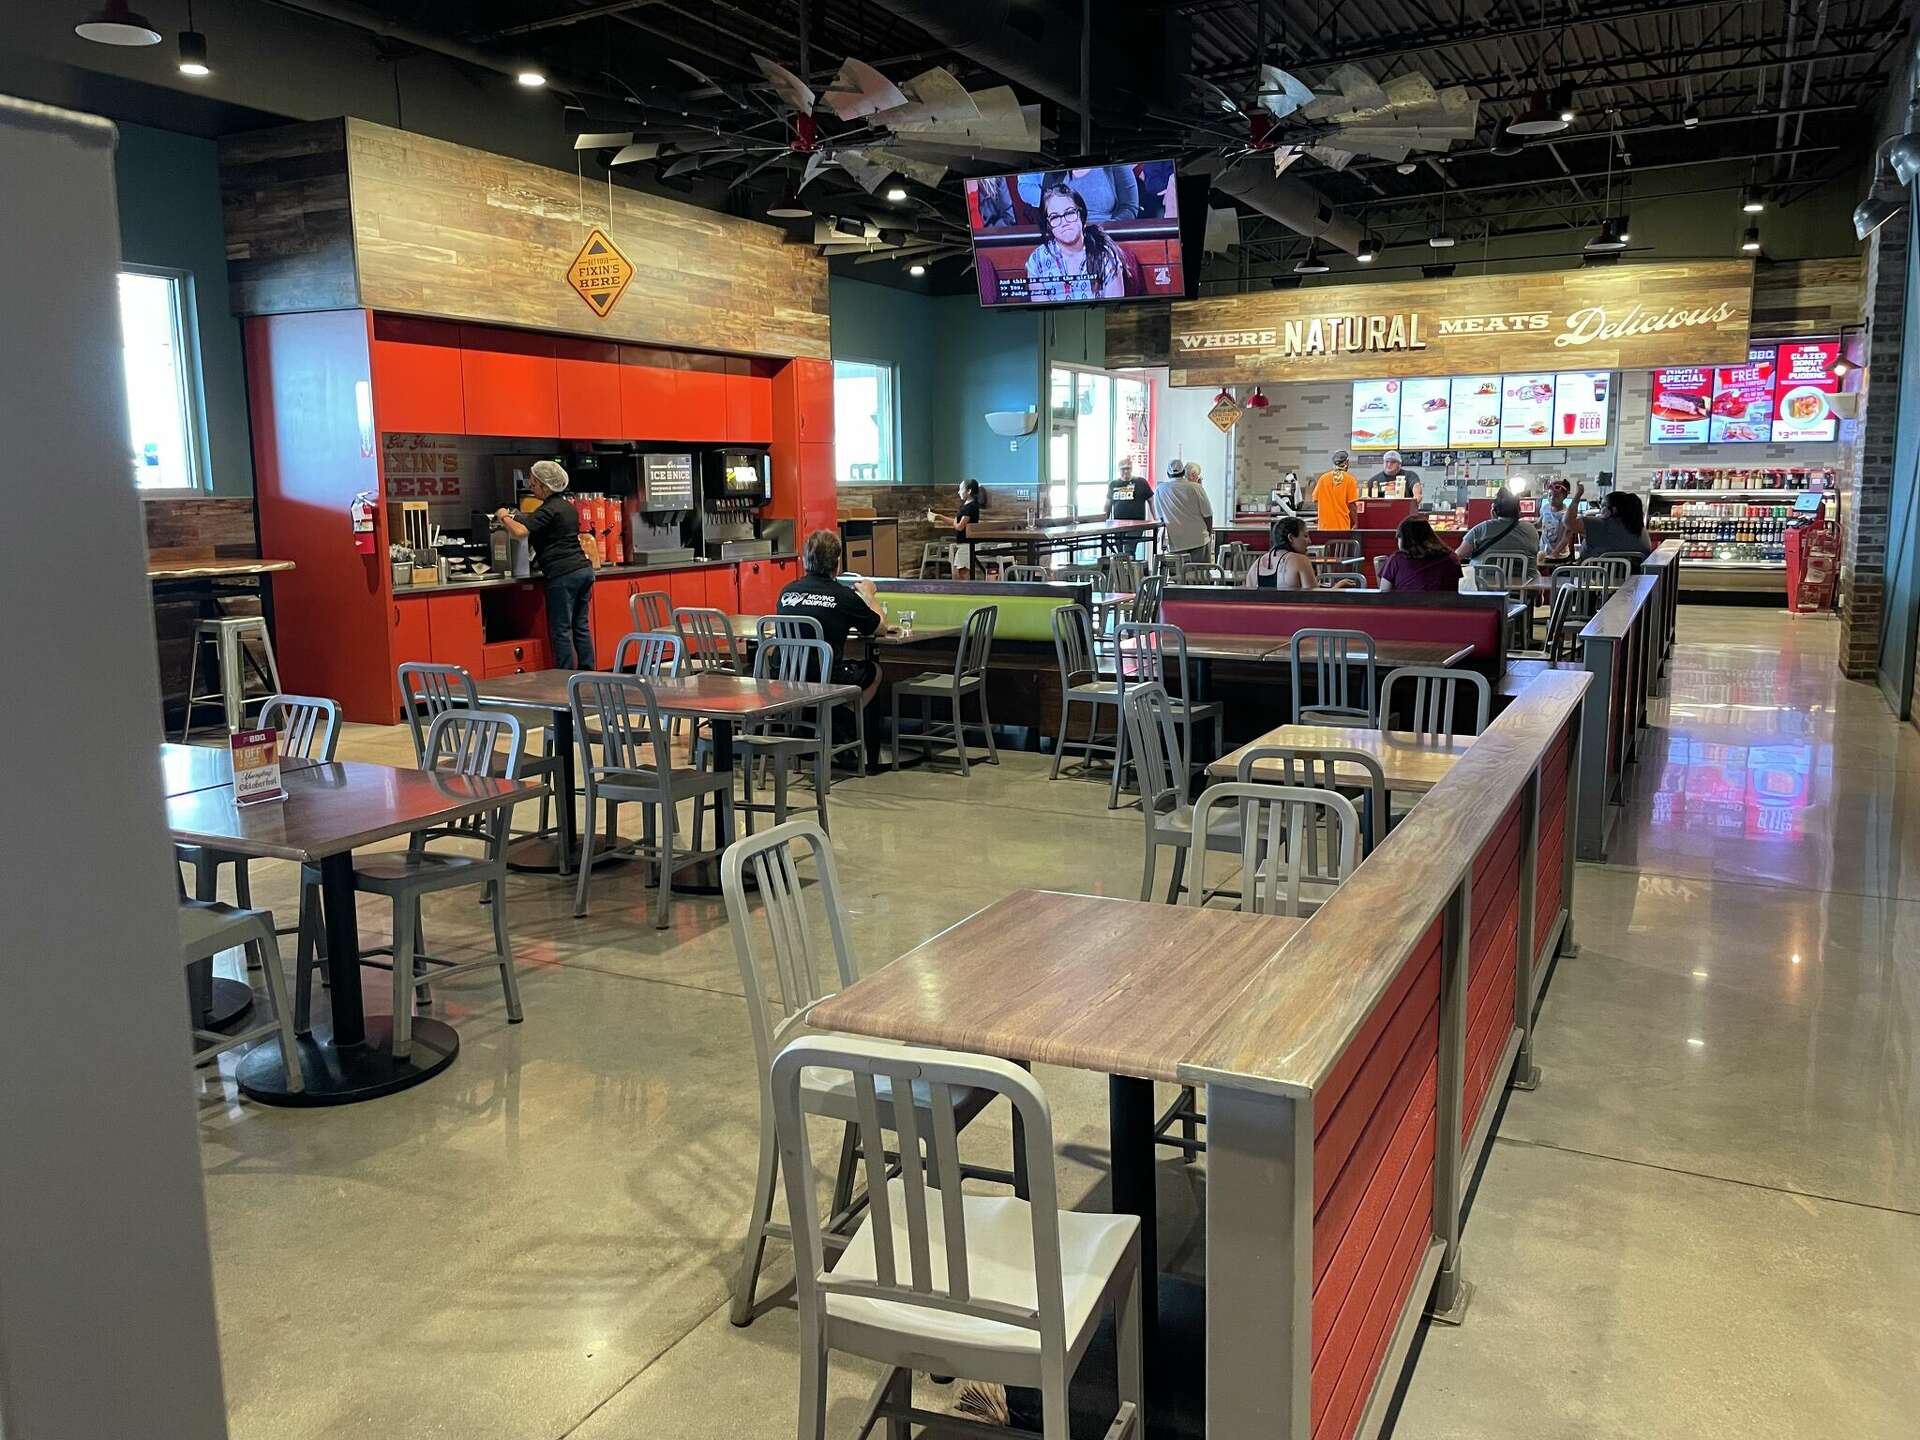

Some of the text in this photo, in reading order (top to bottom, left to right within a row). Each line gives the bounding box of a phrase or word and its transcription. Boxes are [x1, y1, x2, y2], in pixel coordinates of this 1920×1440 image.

[579, 264, 620, 277] FIXIN'S
[579, 276, 620, 288] HERE
[1180, 302, 1736, 355] WHERE NATURAL MEATS Delicious
[1659, 374, 1707, 383] SPECIAL
[1731, 368, 1760, 382] FREE
[1579, 417, 1601, 430] BEER
[384, 452, 459, 473] IXIN'S
[650, 470, 667, 480] ICE
[672, 470, 690, 480] NICE
[806, 593, 836, 602] MOVING
[801, 599, 837, 609] EQUIPMENT
[244, 747, 261, 758] OFF
